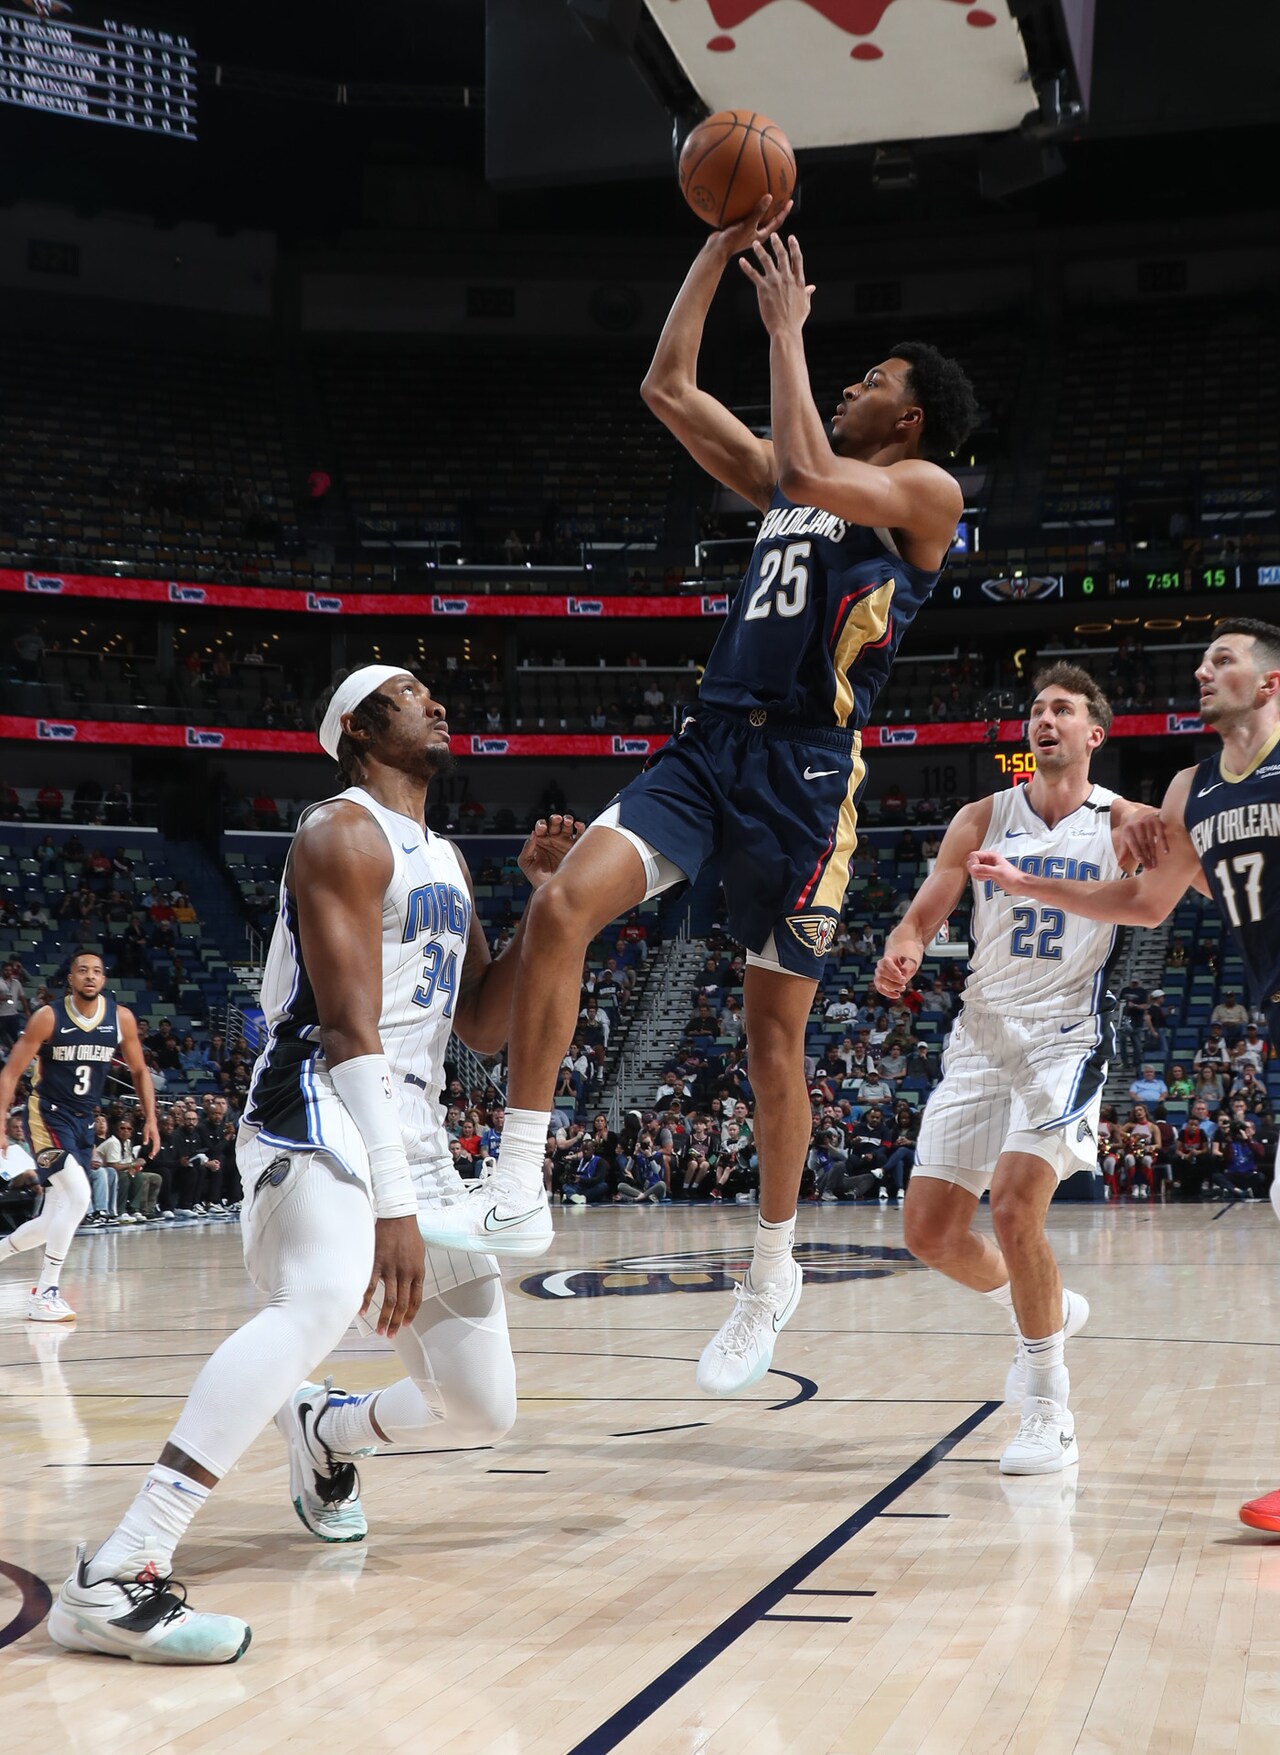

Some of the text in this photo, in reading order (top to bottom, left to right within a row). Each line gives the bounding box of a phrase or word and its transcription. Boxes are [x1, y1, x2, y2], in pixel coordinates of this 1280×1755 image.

[744, 541, 812, 621] 25
[1083, 577, 1094, 594] 6
[1146, 573, 1180, 589] 7:51
[1203, 570, 1226, 587] 15
[994, 752, 1036, 773] 7:50
[435, 775, 469, 803] 117
[921, 765, 957, 794] 118
[1214, 851, 1265, 928] 17
[1010, 907, 1066, 961] 22
[411, 941, 458, 1018] 34
[52, 1045, 77, 1061] NEW
[73, 1065, 92, 1096] 3
